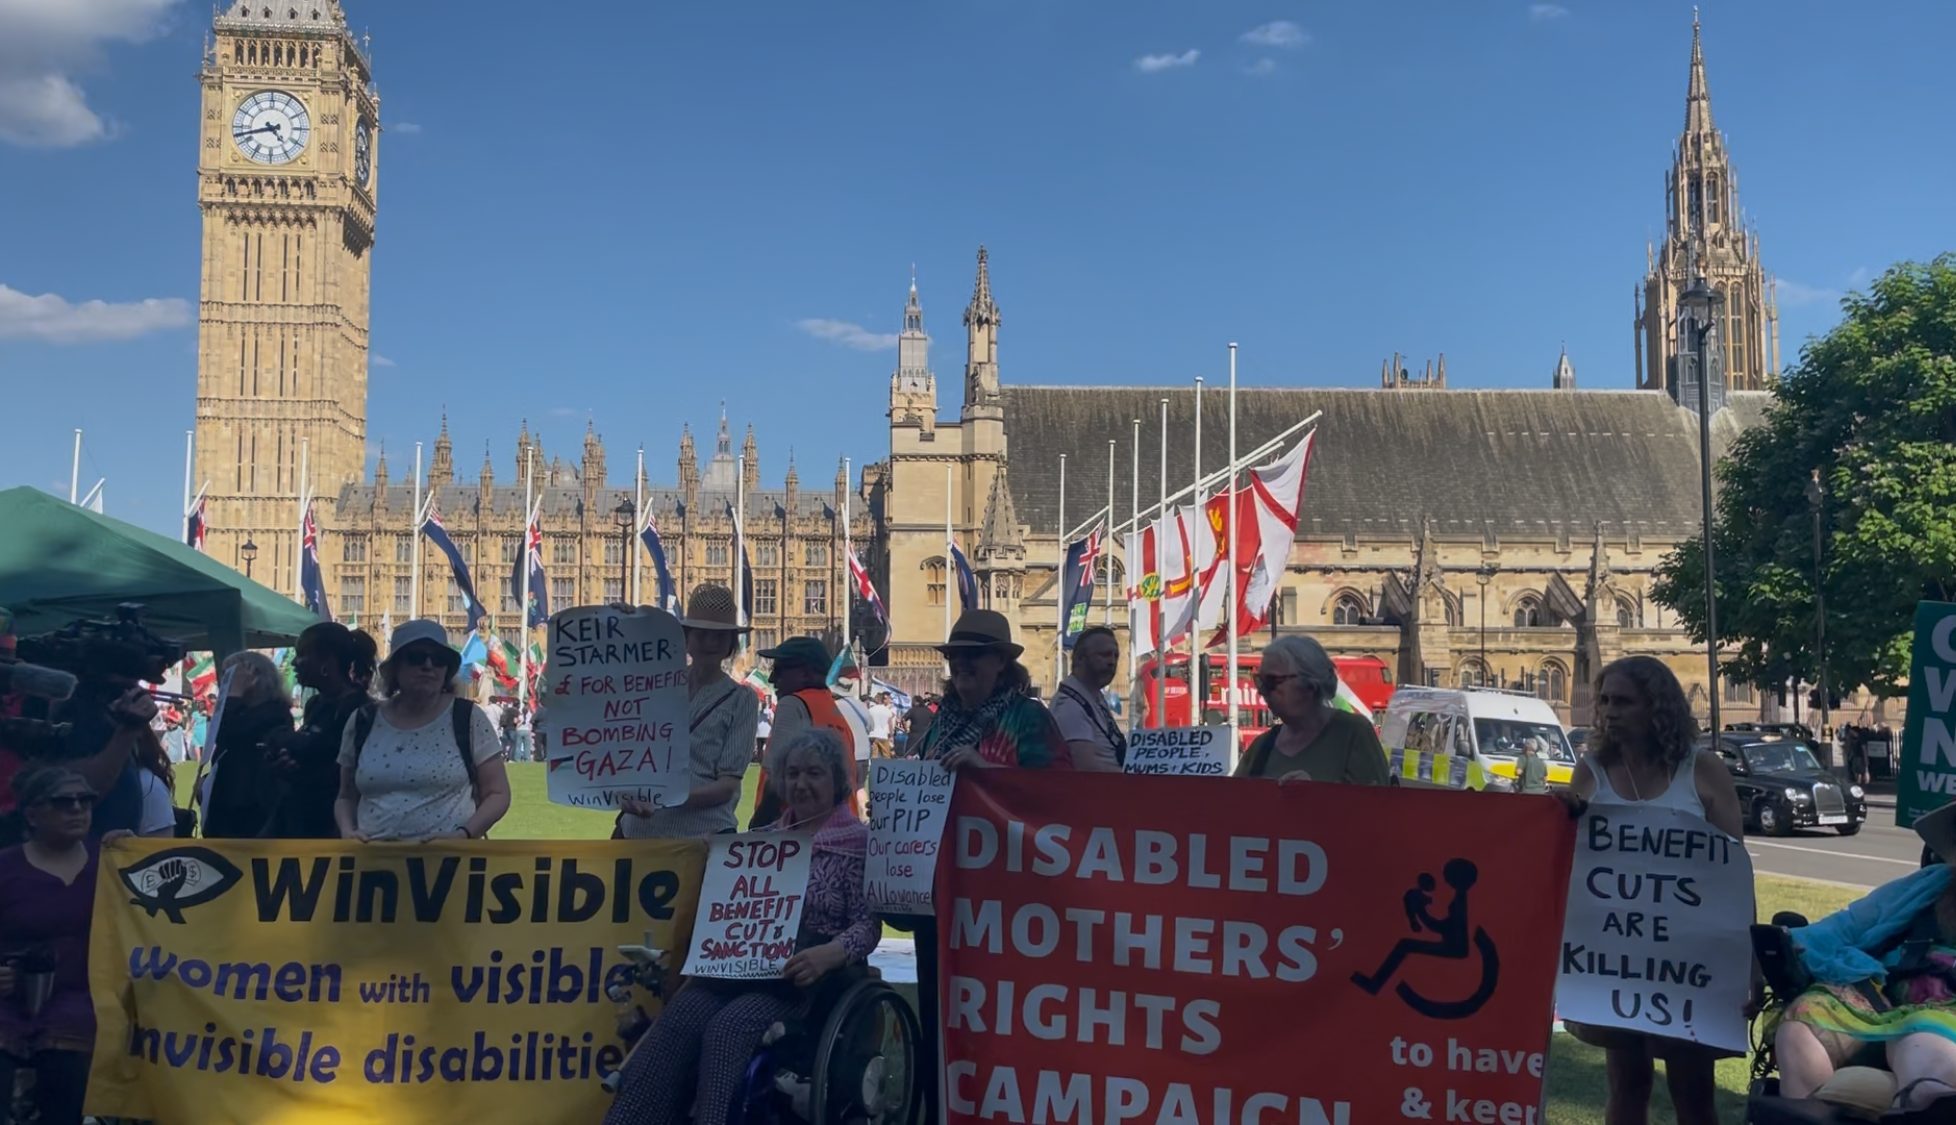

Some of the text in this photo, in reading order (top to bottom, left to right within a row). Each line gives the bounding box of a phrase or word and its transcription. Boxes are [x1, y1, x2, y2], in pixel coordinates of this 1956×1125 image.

[556, 612, 624, 643] KEIR
[581, 675, 617, 696] FOR
[624, 669, 688, 693] BENEFITS
[603, 697, 650, 719] NOT
[562, 721, 674, 747] BOMBING
[1130, 730, 1213, 747] DISABLED
[876, 765, 950, 787] Disabled
[1124, 763, 1169, 774] MUMS
[1180, 762, 1223, 774] KIDS
[870, 788, 945, 810] people lose
[892, 808, 930, 833] PIP
[868, 837, 937, 857] Our carers
[1588, 815, 1730, 864] BENEFIT
[723, 840, 801, 871] STOP
[886, 857, 914, 878] lose
[955, 815, 1329, 897] DISABLED
[251, 856, 680, 924] WinVisible
[730, 874, 779, 900] ALL
[866, 880, 932, 905] Allowance
[1586, 866, 1702, 907] CUTS
[709, 895, 801, 922] BENEFIT
[949, 897, 1344, 983] MOTHERS'
[1602, 912, 1669, 942] ARE
[128, 946, 633, 1005] women with visible
[1562, 942, 1712, 988] KILLING
[947, 975, 1222, 1055] RIGHTS
[1611, 989, 1693, 1028] US!
[129, 1022, 623, 1084] nvisible disabilitie
[1390, 1036, 1544, 1078] to have
[1401, 1087, 1433, 1120] &
